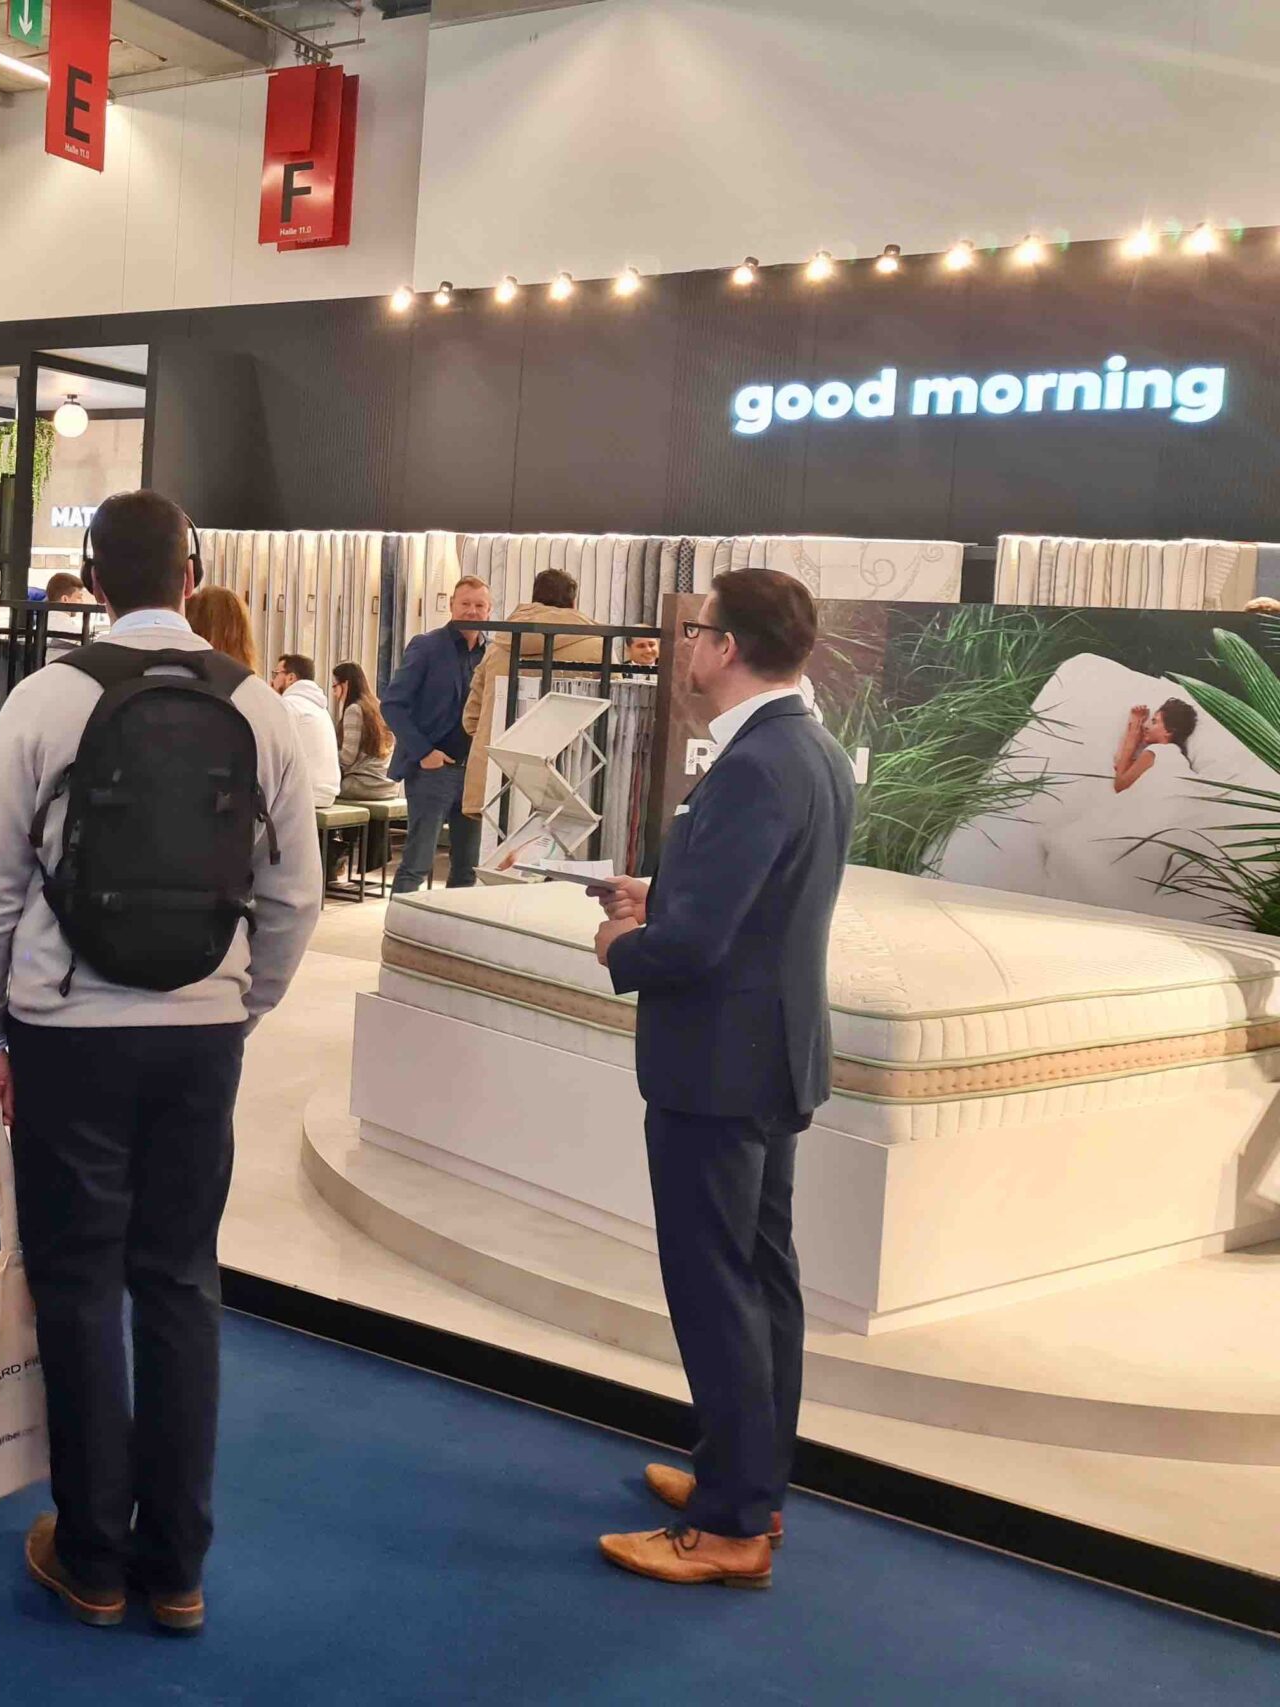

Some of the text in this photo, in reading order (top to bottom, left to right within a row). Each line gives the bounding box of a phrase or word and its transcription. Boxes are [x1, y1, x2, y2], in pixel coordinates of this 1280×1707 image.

[65, 65, 92, 144] E
[64, 142, 90, 160] Halle 11.0
[281, 161, 314, 223] F
[280, 226, 312, 236] Halle 11.0
[732, 354, 1226, 435] good morning
[51, 506, 97, 528] MAT
